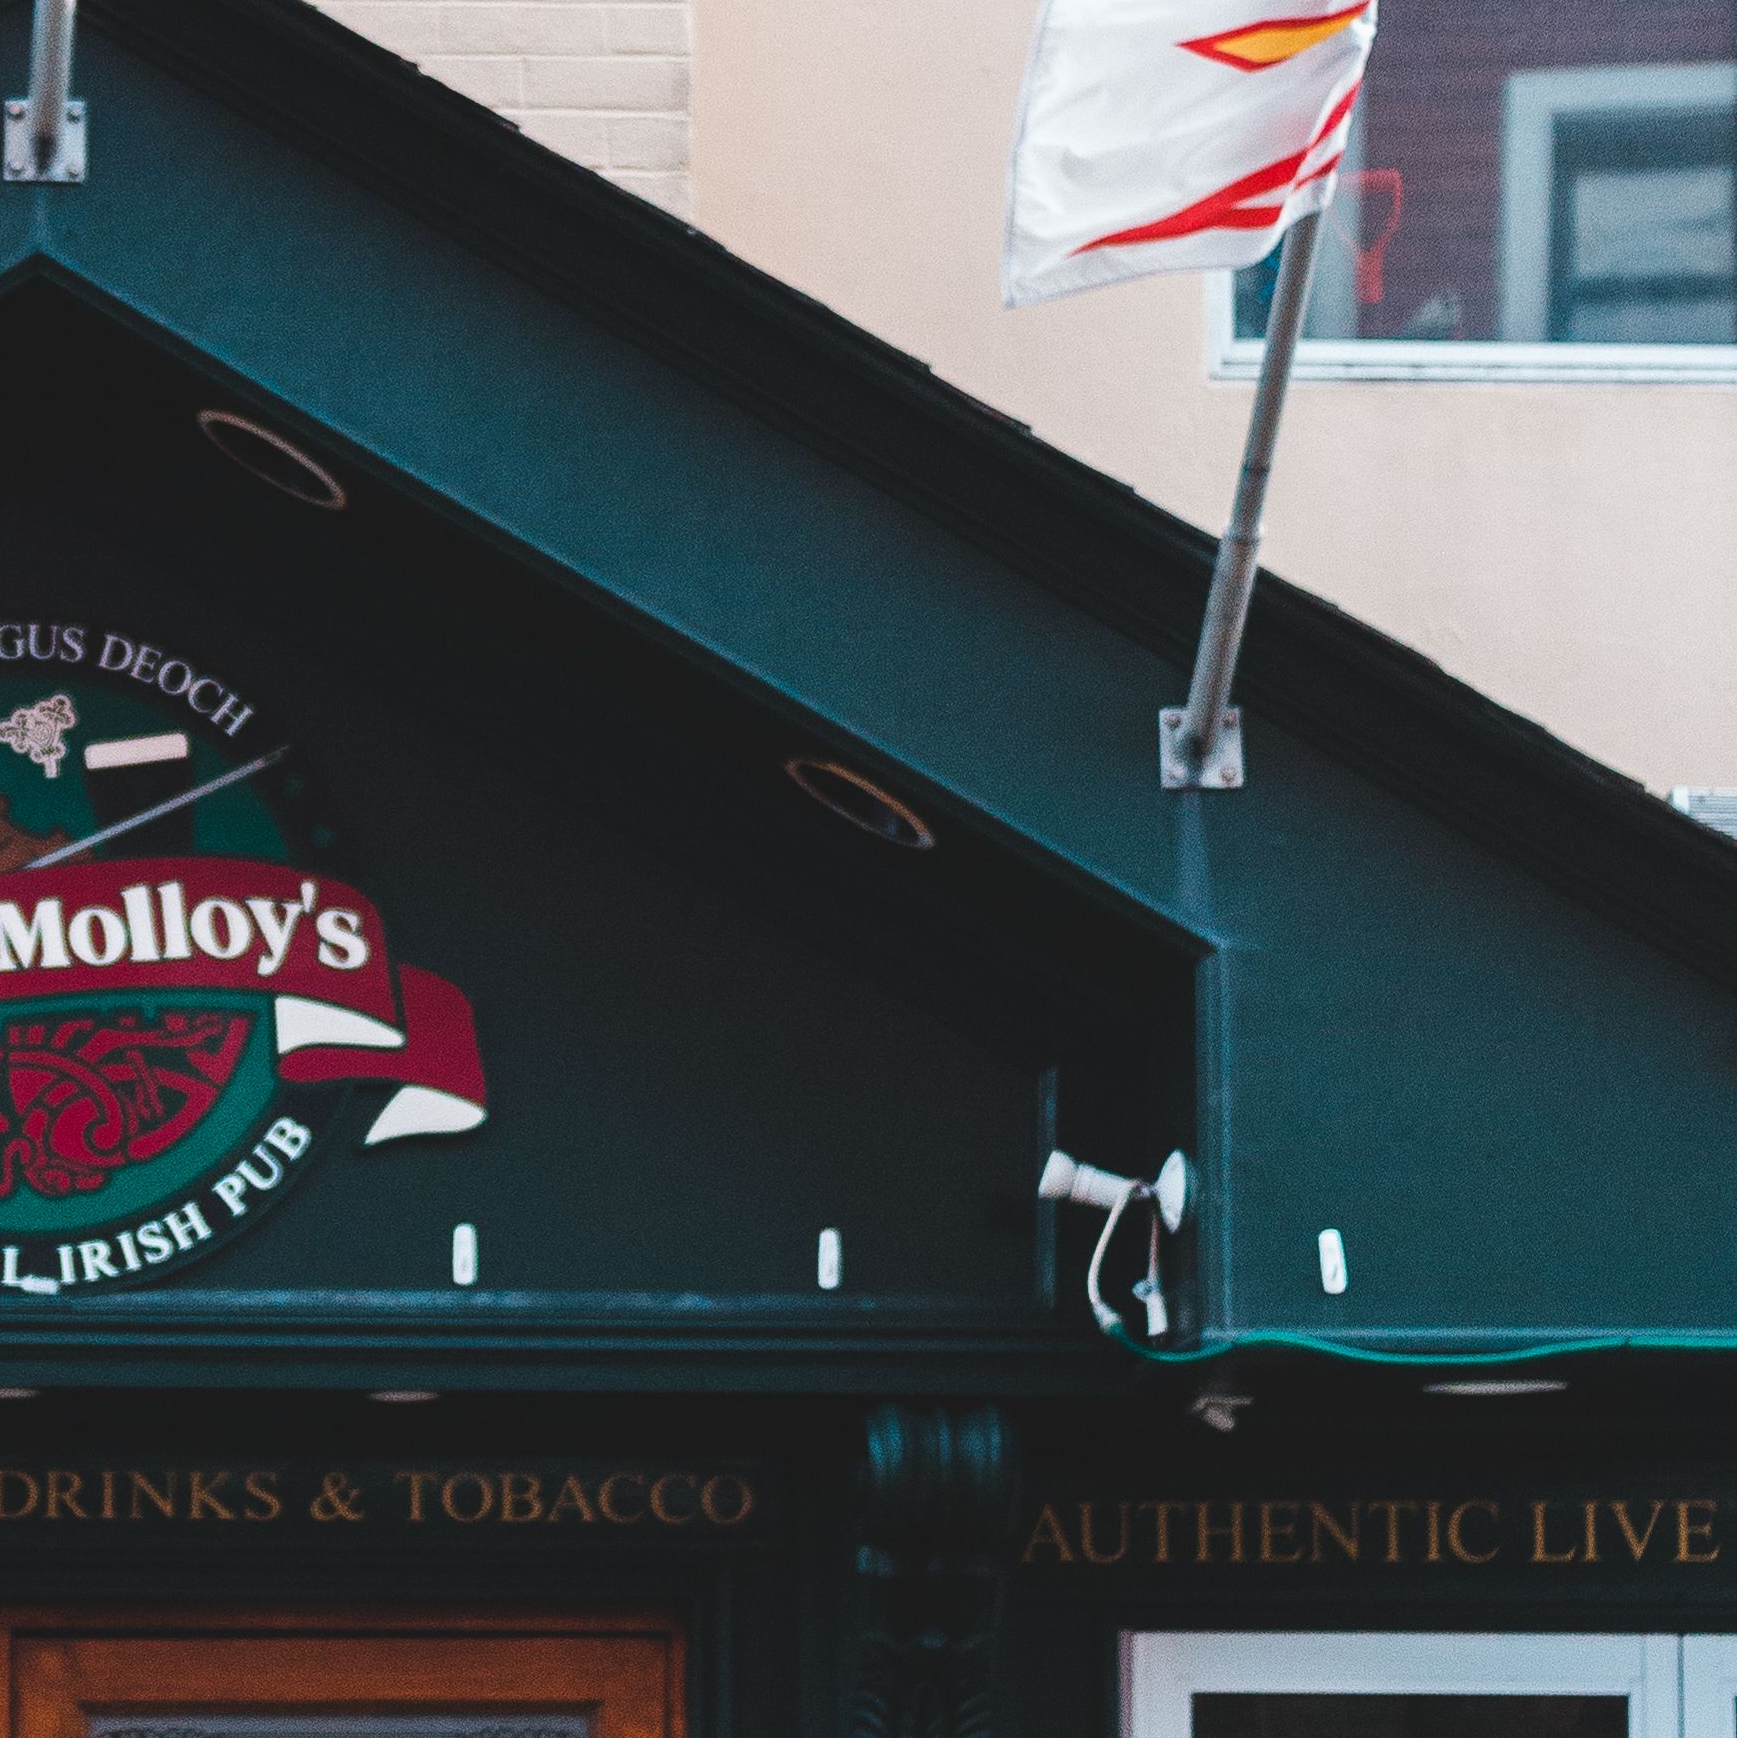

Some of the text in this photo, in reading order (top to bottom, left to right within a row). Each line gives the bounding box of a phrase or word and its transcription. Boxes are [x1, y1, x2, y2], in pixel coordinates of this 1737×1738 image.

[100, 632, 255, 738] DEOCH
[59, 1200, 213, 1287] IRISH
[213, 1113, 314, 1223] PUB
[308, 1470, 365, 1523] &
[394, 1469, 755, 1526] TOBACCO
[1020, 1499, 1722, 1564] AUTHENTIC LIVE
